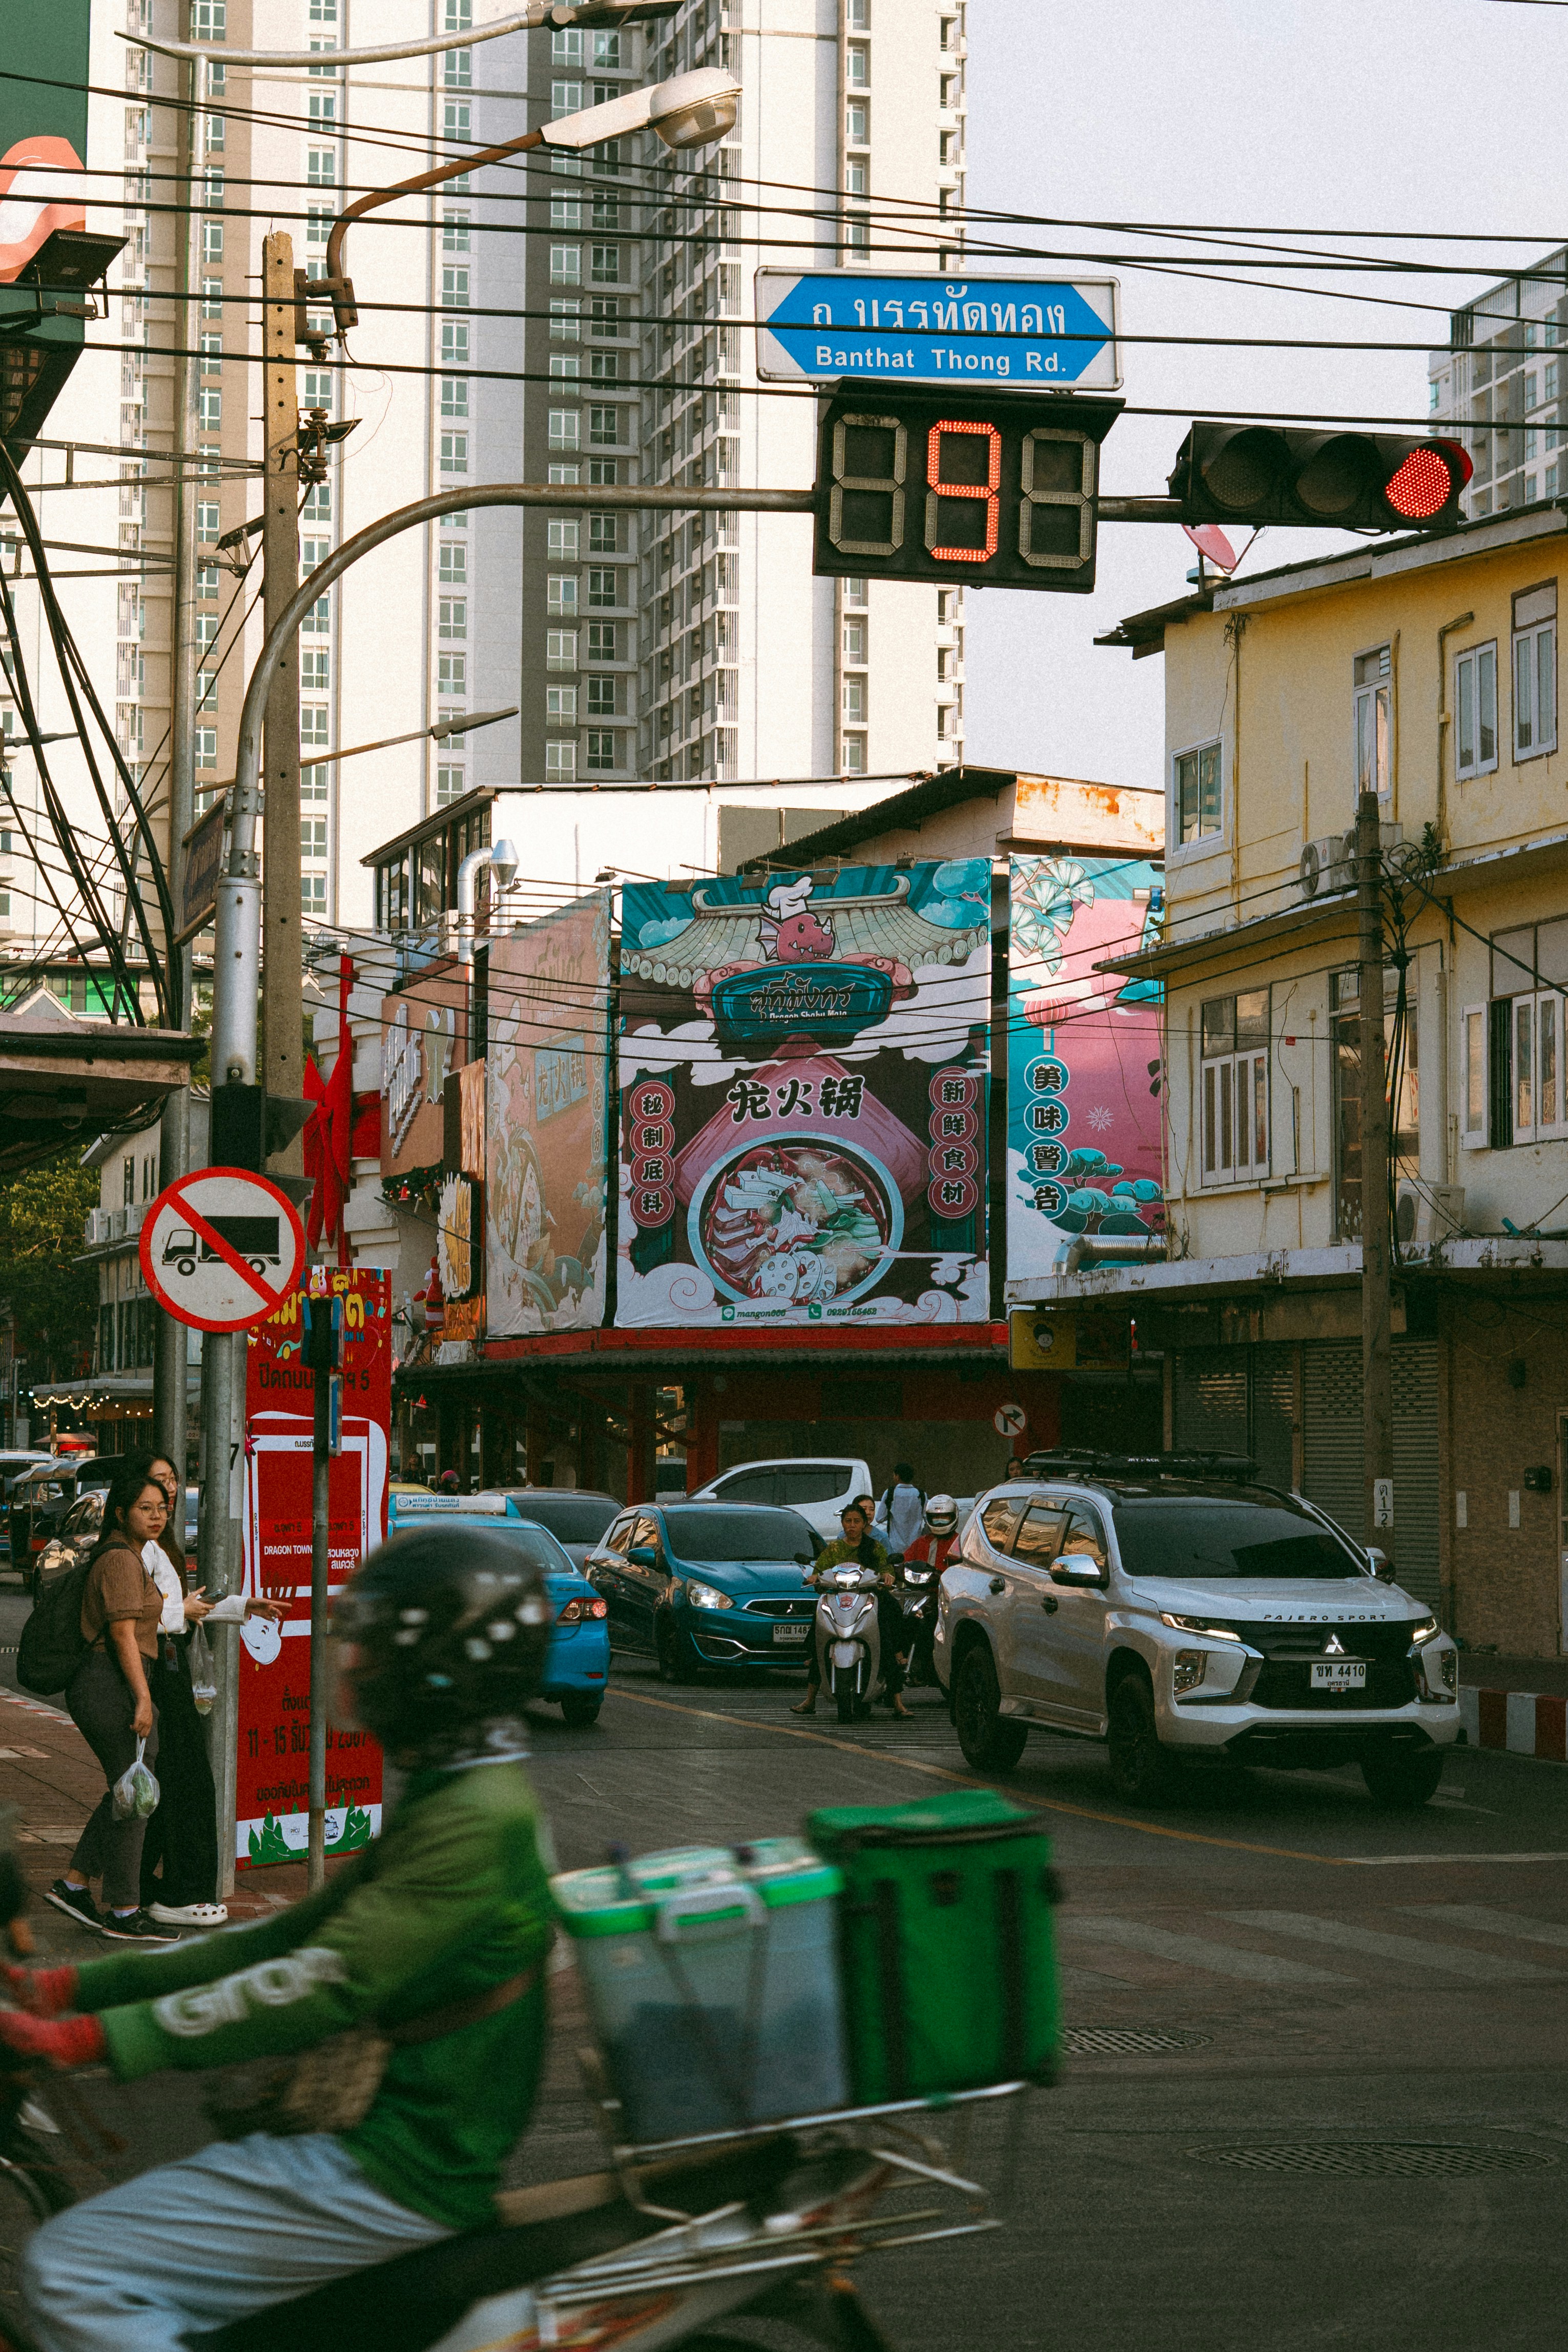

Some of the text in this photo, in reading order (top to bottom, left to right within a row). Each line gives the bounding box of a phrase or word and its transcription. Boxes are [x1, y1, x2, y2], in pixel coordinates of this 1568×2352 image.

[816, 345, 1066, 376] Banthat Thong Rd.
[727, 1074, 865, 1125] 龙火锅
[641, 1092, 665, 1214] 秘制底料
[942, 1079, 967, 1205] 新鲜食材
[1033, 1064, 1062, 1212] 美味警告
[264, 1545, 313, 1556] DRAGON TOWN
[1338, 1665, 1365, 1677] 4410
